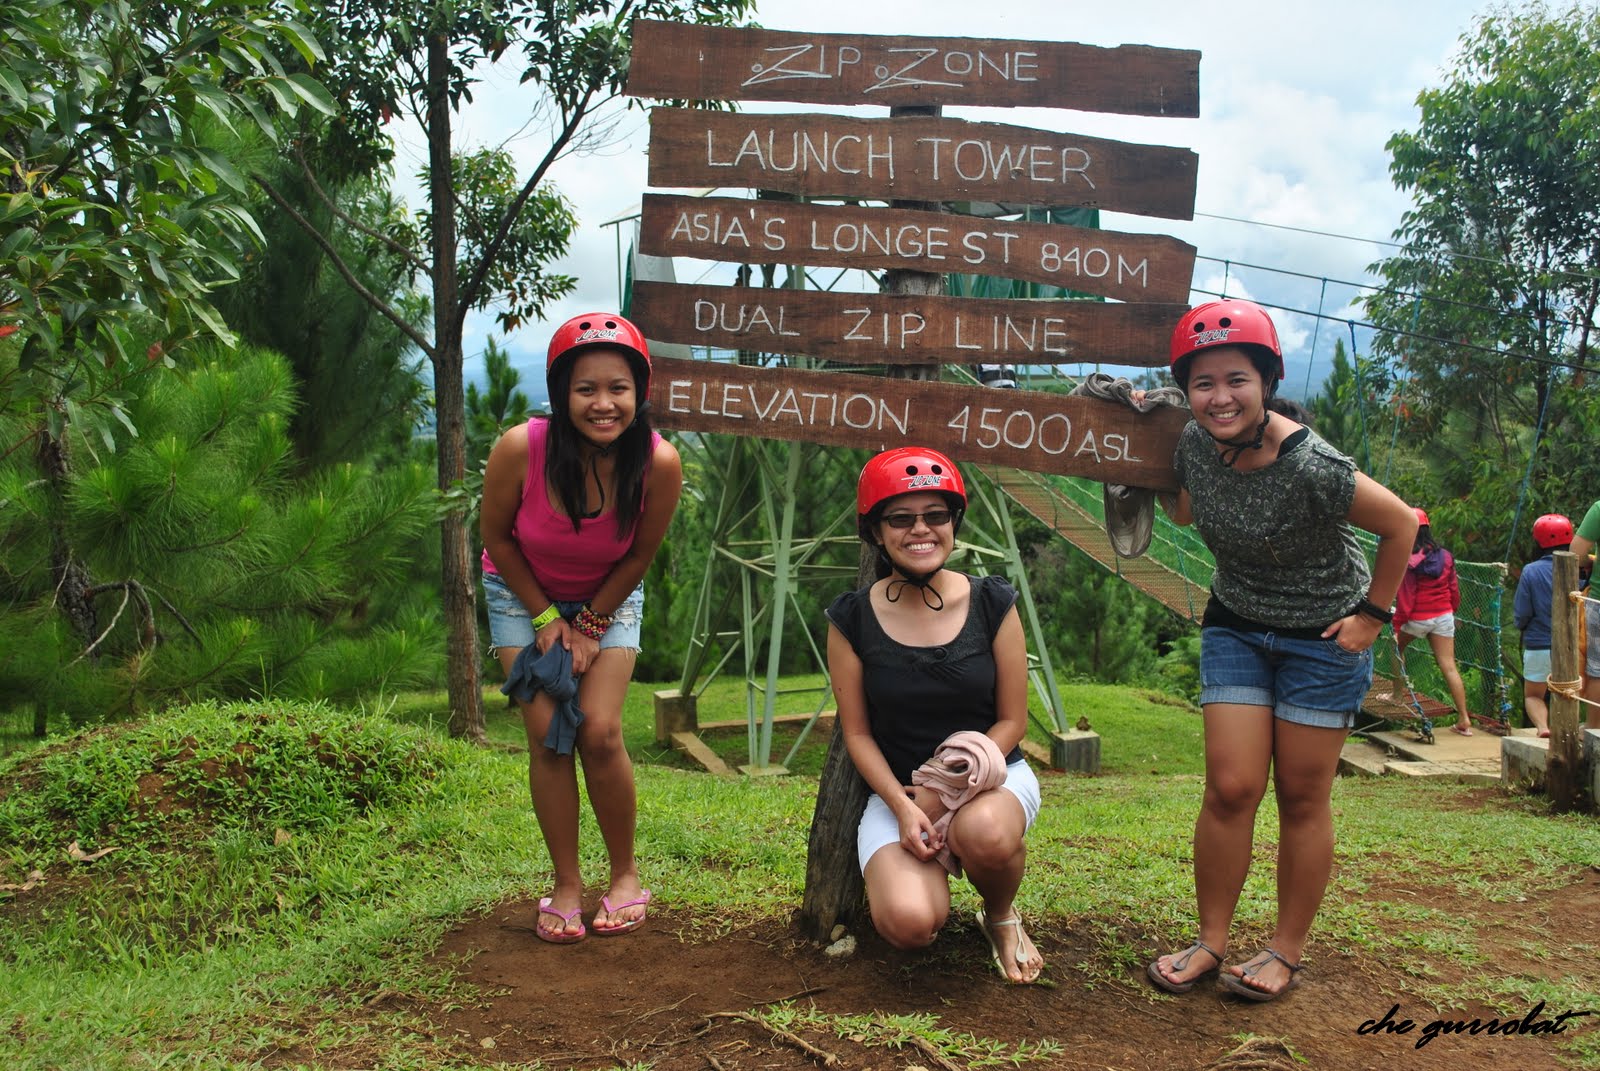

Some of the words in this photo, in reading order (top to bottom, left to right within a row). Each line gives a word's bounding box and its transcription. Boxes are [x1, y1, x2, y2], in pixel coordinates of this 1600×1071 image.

[706, 128, 895, 180] LAUNCH
[916, 136, 1096, 190] TOWER
[671, 207, 786, 251] ASIA'S
[1040, 242, 1148, 289] 840M
[693, 298, 801, 337] DUAL
[842, 307, 927, 350] ZIP
[954, 313, 1069, 353] LINE
[668, 379, 911, 436] ELEVATION
